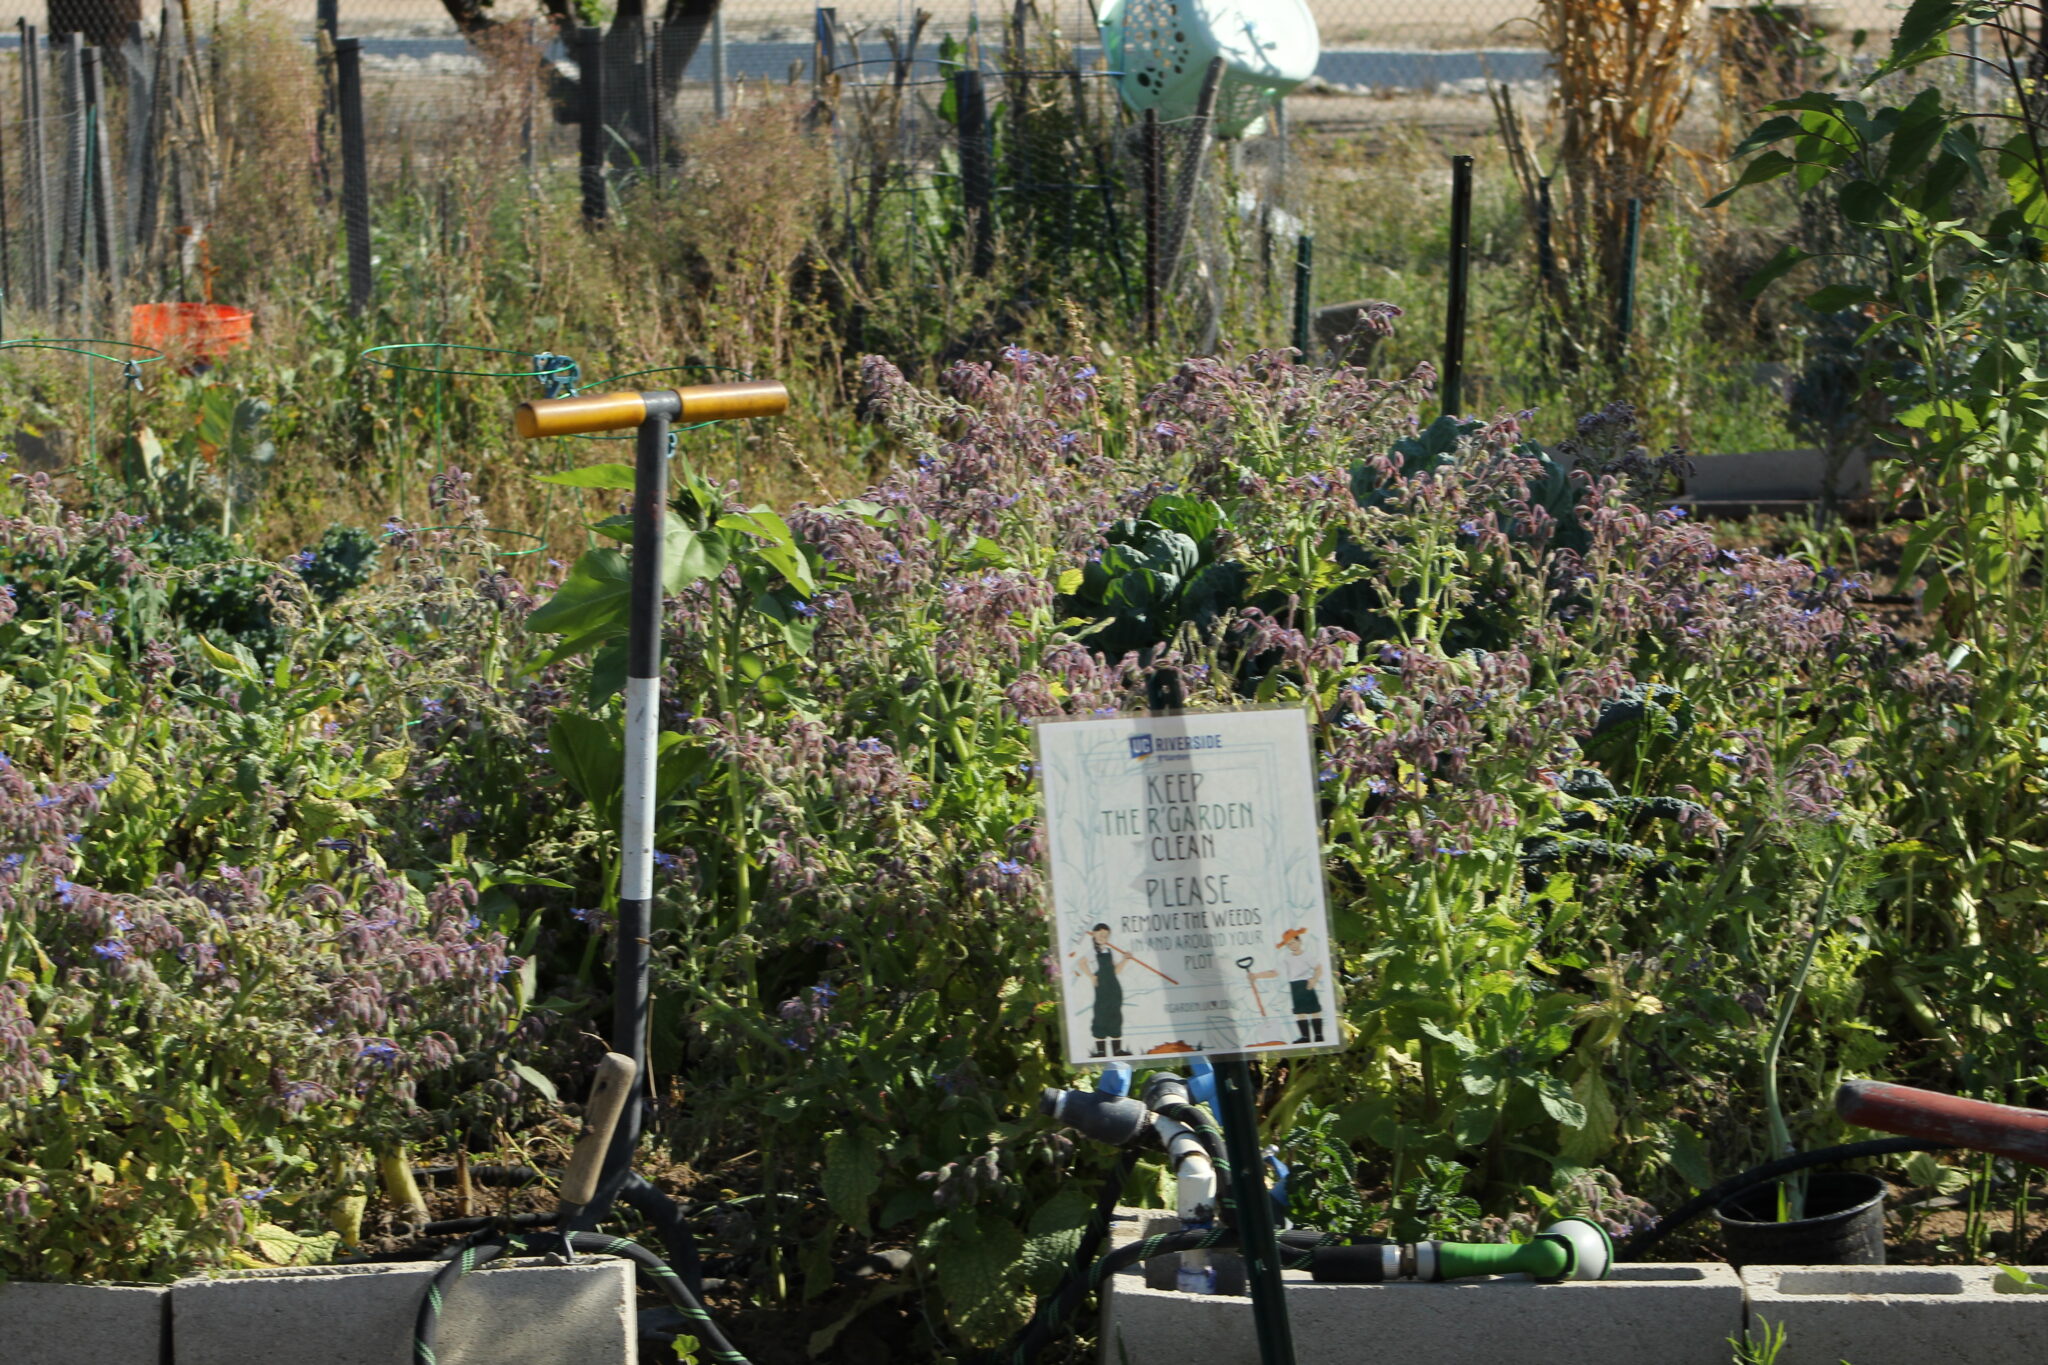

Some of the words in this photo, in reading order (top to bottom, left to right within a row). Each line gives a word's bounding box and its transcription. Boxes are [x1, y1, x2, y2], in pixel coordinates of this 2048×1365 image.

[1132, 737, 1151, 753] UC
[1155, 734, 1222, 751] RIVERSIDE
[1147, 773, 1204, 805] KEEP
[1101, 809, 1141, 836] THE
[1147, 802, 1254, 834] R'GARDEN
[1151, 834, 1215, 861] CLEAN
[1145, 875, 1231, 908] PLEASE
[1120, 913, 1180, 933] REMOVE
[1183, 911, 1209, 929] THE
[1211, 908, 1262, 927] WEEDS
[1147, 936, 1173, 951] AND
[1175, 932, 1226, 949] AROUND
[1228, 930, 1264, 946] YOUR
[1184, 954, 1214, 970] PLOT
